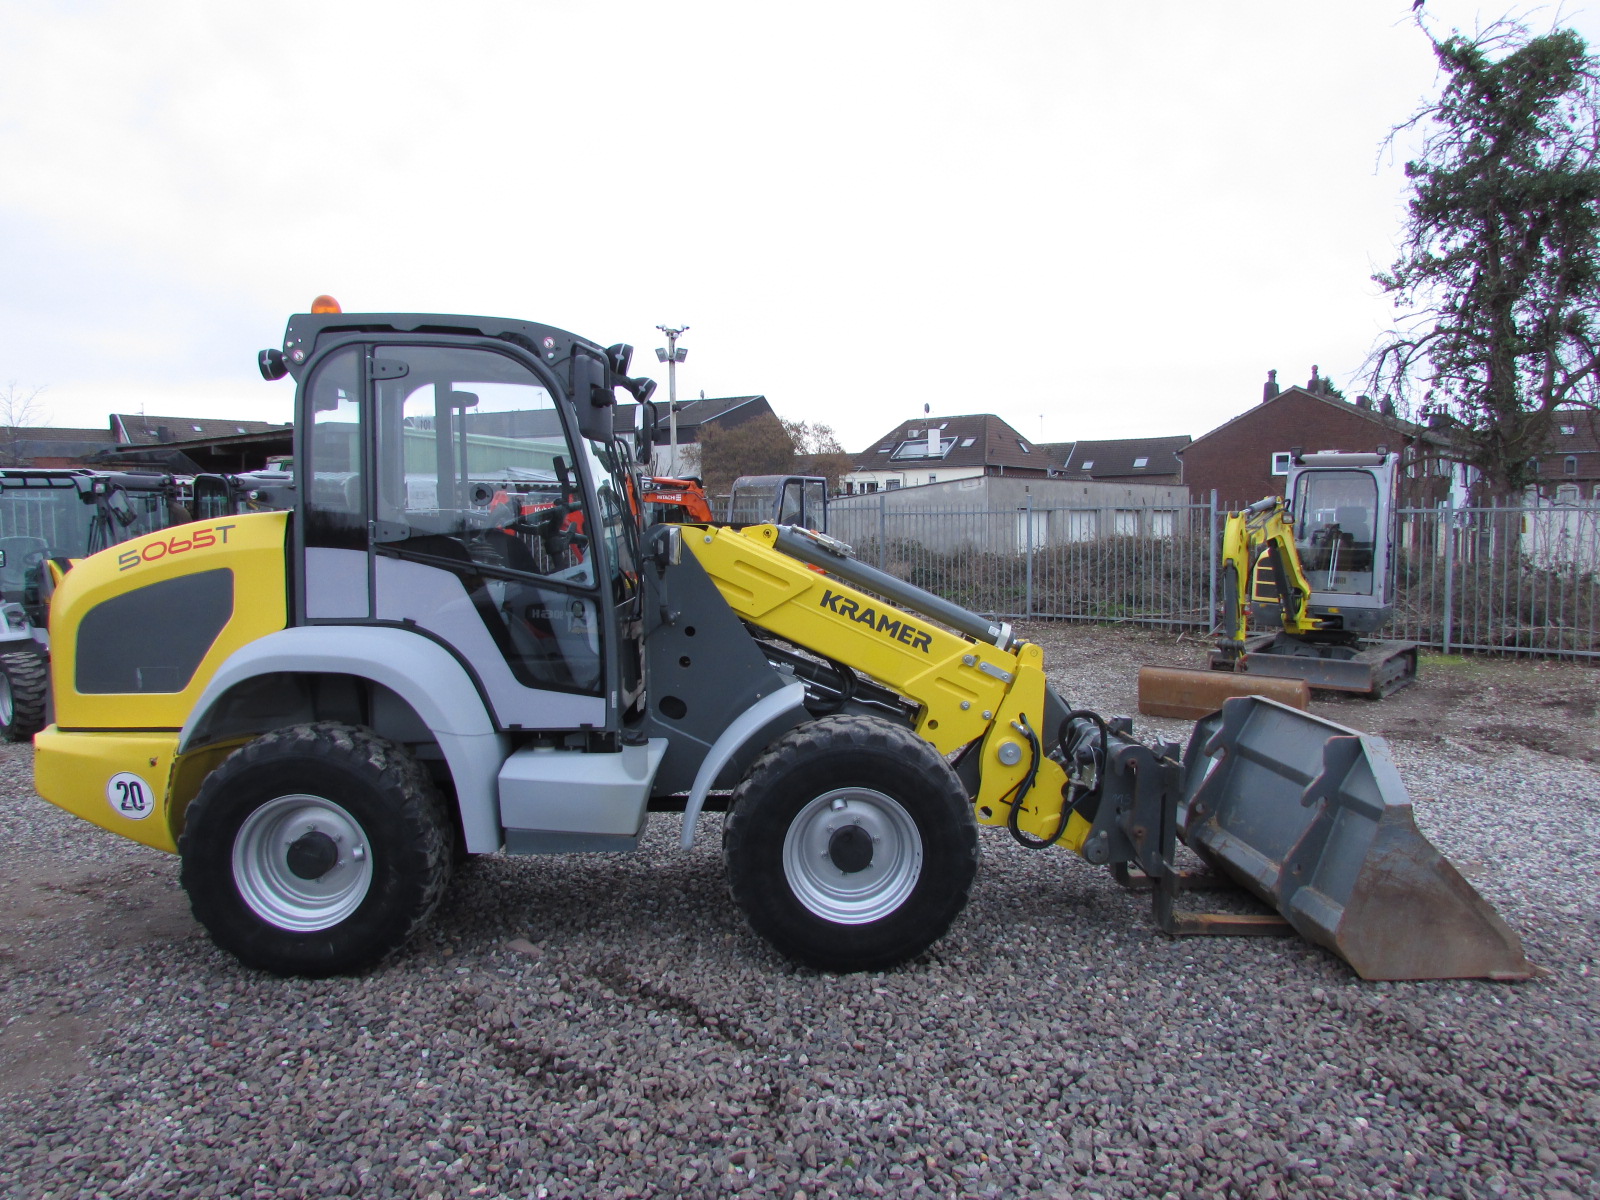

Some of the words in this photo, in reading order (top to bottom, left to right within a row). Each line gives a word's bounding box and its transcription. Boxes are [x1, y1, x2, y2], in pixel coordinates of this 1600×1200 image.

[118, 525, 236, 571] 5065T
[820, 590, 932, 653] KRAMER
[116, 781, 145, 811] 20
